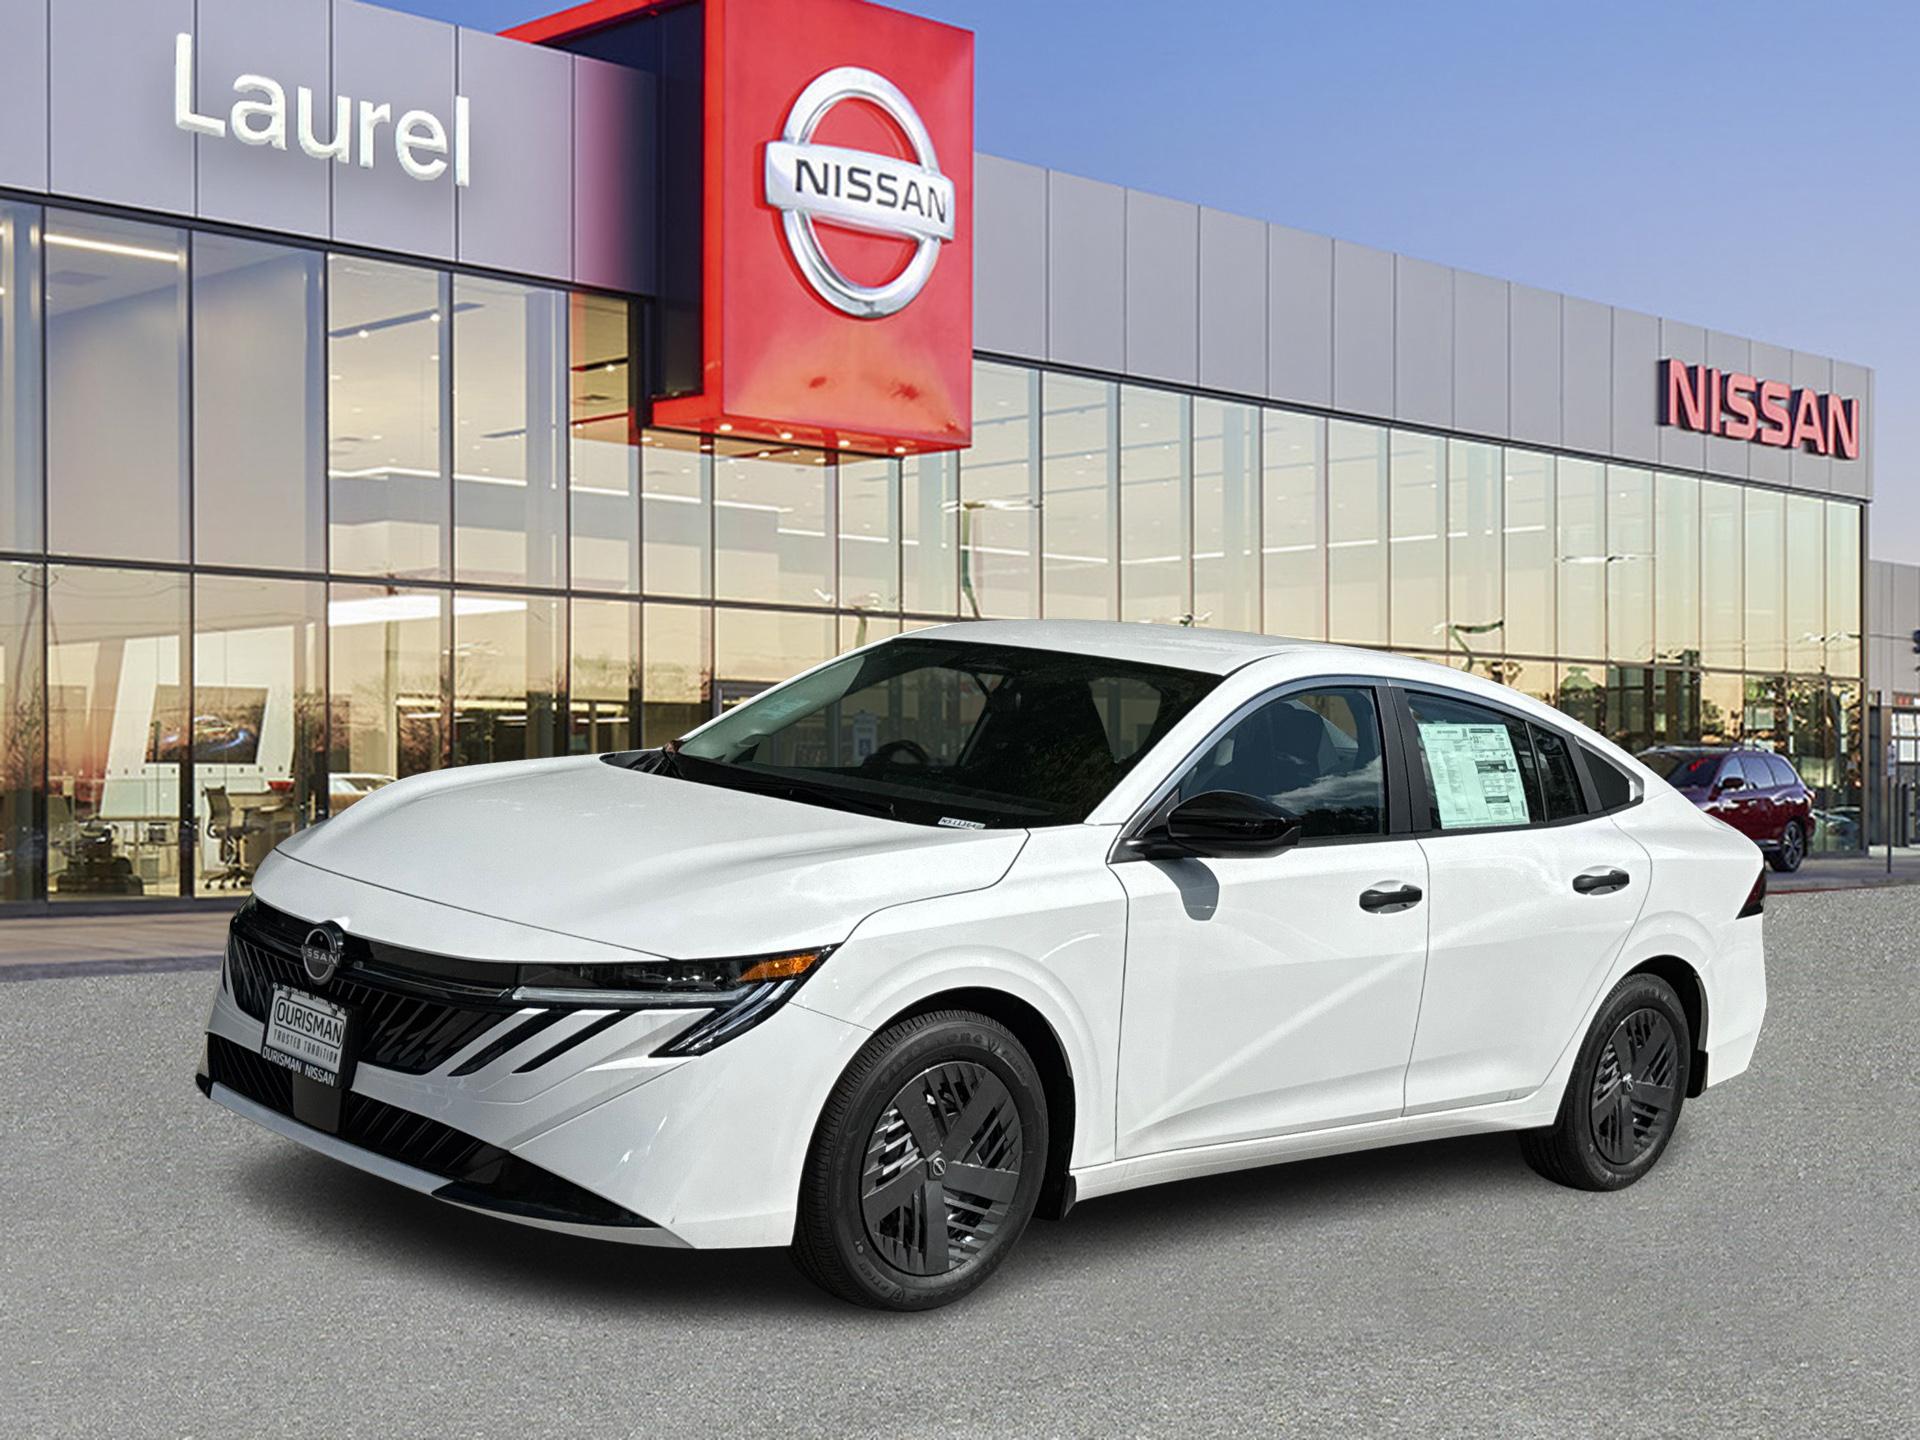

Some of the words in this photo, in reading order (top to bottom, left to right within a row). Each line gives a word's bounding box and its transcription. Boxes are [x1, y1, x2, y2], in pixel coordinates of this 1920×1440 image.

[174, 32, 470, 187] Laurel
[795, 158, 946, 224] NISSAN
[1657, 357, 1860, 461] NISSAN
[273, 1028, 301, 1050] TRUSTED
[303, 1040, 339, 1064] TRADITION
[276, 1001, 343, 1044] OURISMAN
[262, 1046, 302, 1074] OURISMAN
[304, 1064, 336, 1087] NISSAN
